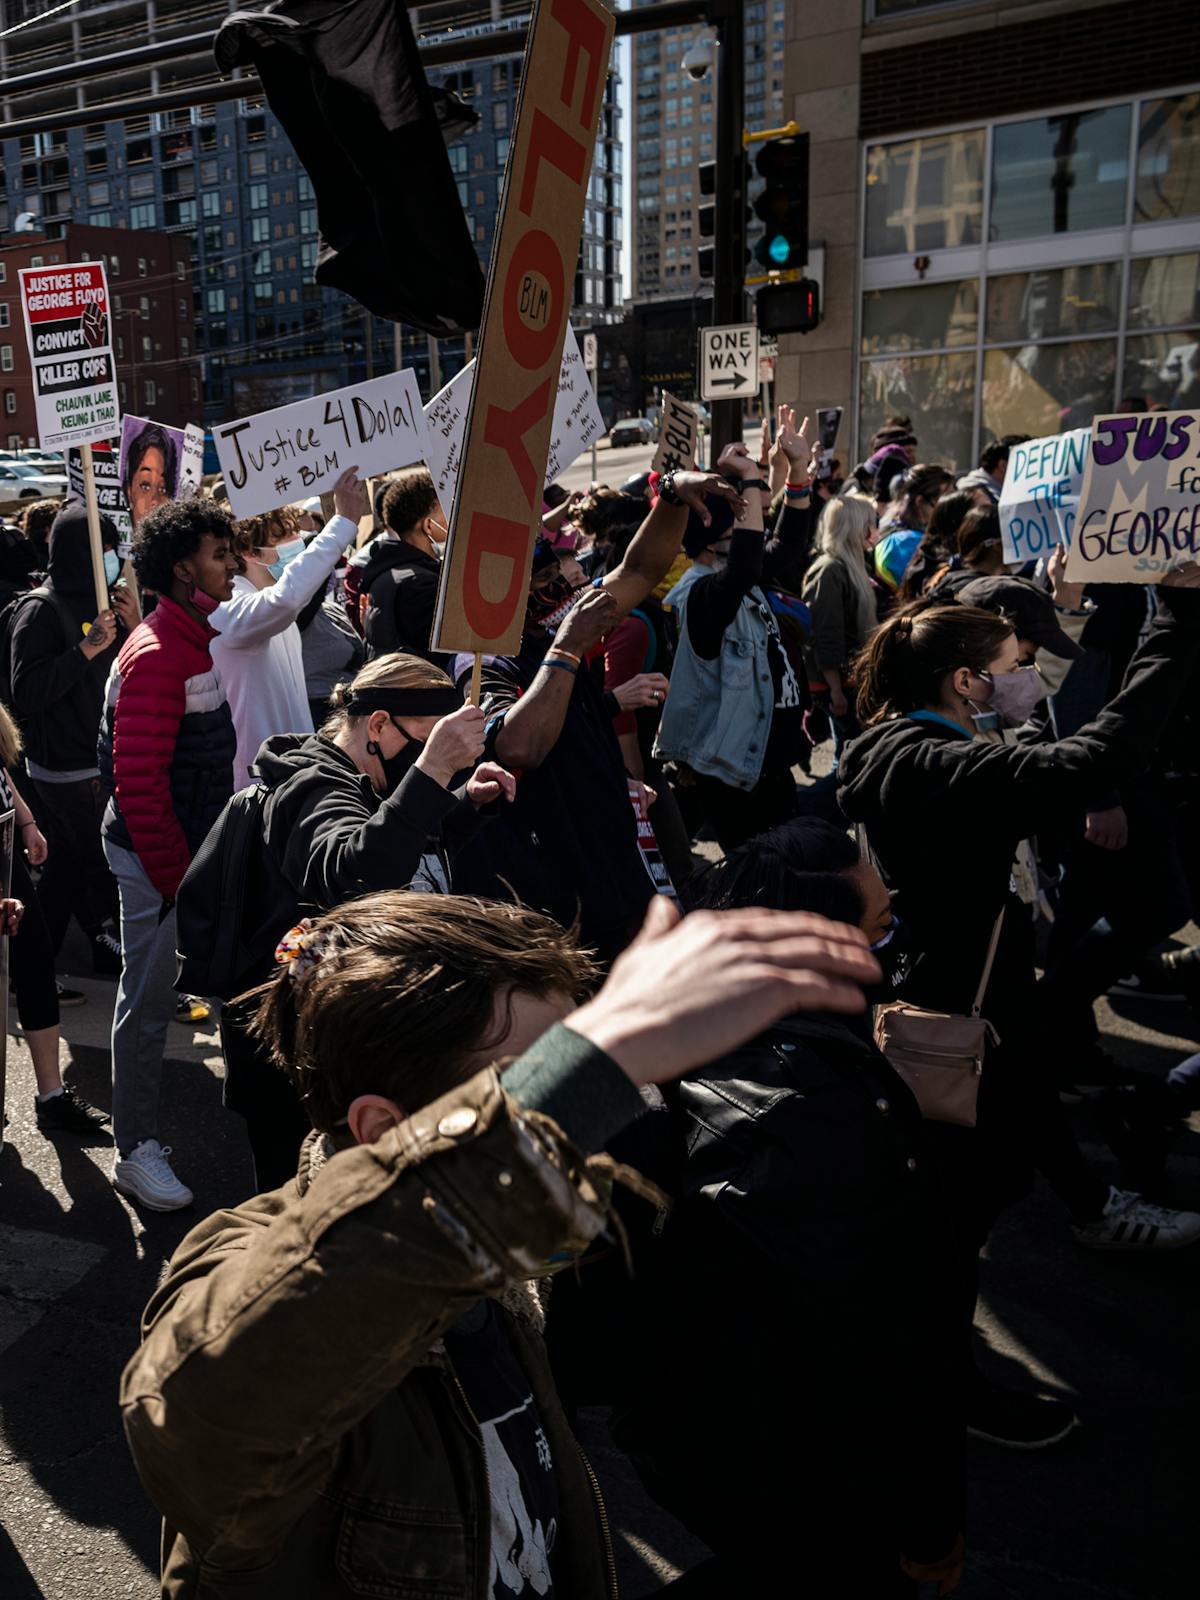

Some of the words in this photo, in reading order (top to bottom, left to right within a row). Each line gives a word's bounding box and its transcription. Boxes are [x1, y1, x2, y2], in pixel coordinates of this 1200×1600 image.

[27, 274, 72, 293] JUSTICE
[74, 272, 91, 287] FOR
[28, 292, 73, 311] GEORGE
[75, 288, 104, 303] FLOYD
[519, 276, 549, 324] BLM
[463, 0, 607, 640] FLOYD
[36, 329, 85, 351] CONVICT
[710, 331, 751, 351] ONE
[39, 363, 80, 386] KILLER
[82, 357, 107, 378] COPS
[709, 351, 751, 370] WAY
[61, 412, 89, 430] KEUNG
[90, 410, 96, 423] &
[96, 406, 116, 421] THAO
[220, 421, 321, 490] Justice
[323, 399, 352, 448] 4
[1092, 415, 1200, 466] JUS
[70, 457, 118, 475] JUTICE
[1013, 433, 1092, 483] DEFUN
[1028, 478, 1075, 514] THE
